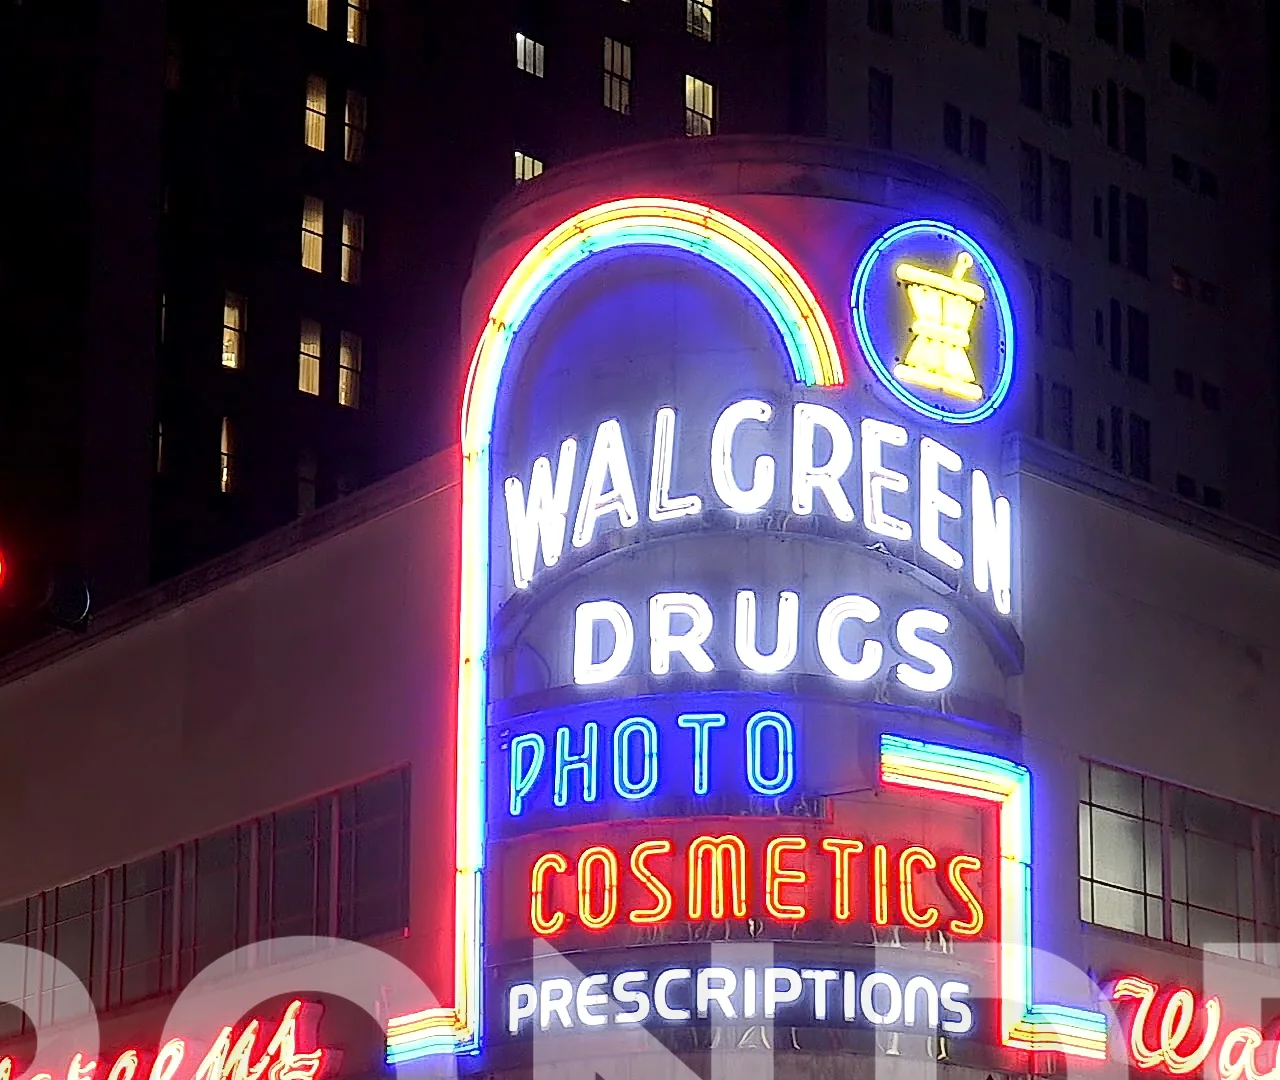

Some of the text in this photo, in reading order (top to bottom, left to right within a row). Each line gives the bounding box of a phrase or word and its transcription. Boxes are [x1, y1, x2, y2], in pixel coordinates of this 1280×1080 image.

[504, 398, 1012, 614] WALGREEN
[573, 590, 954, 692] DRUGS
[509, 710, 796, 816] PHOTO
[531, 833, 985, 935] COSMETICS
[507, 966, 973, 1034] PRESCRIPTIONS
